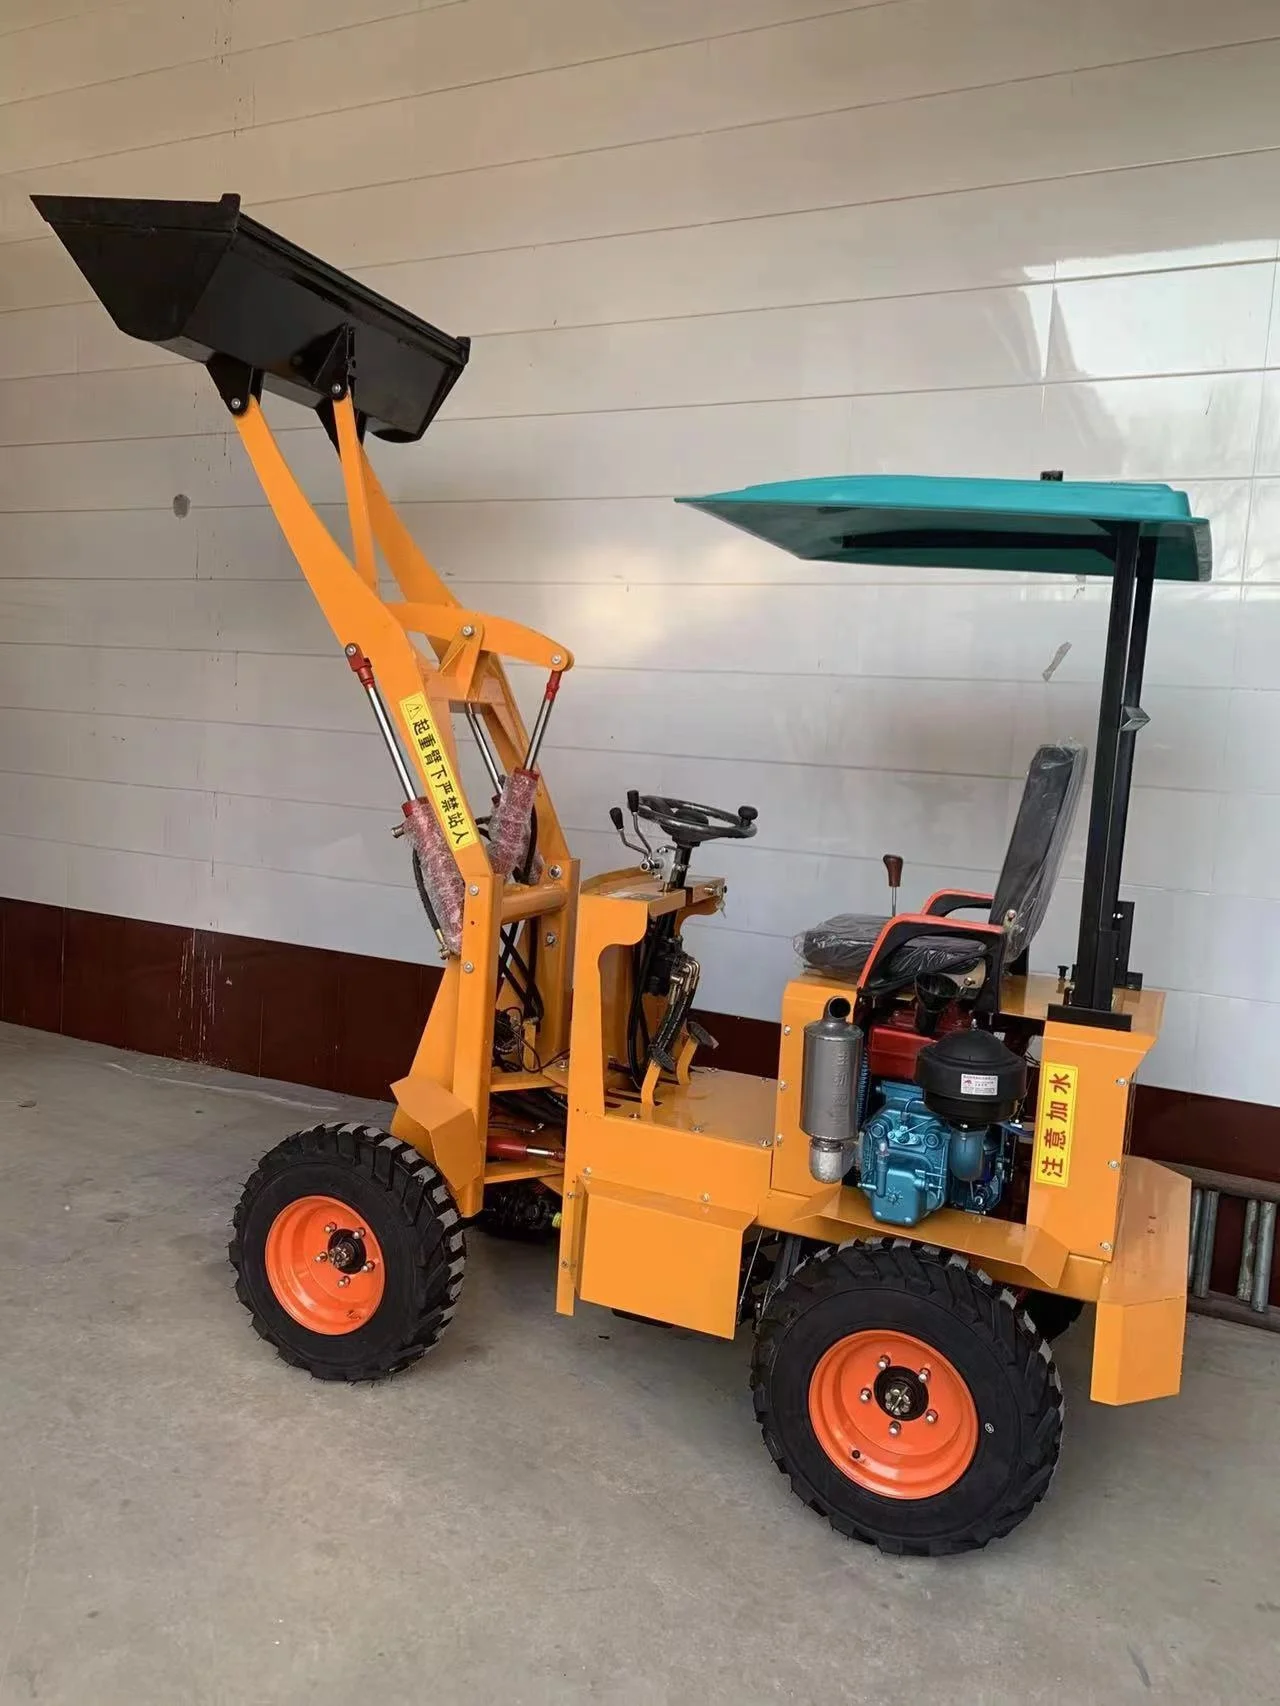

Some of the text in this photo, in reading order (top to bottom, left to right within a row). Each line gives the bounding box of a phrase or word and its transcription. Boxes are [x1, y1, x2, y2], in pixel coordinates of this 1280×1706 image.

[412, 718, 470, 844] 起重臂下严禁站人
[1041, 1072, 1072, 1178] 注意加水
